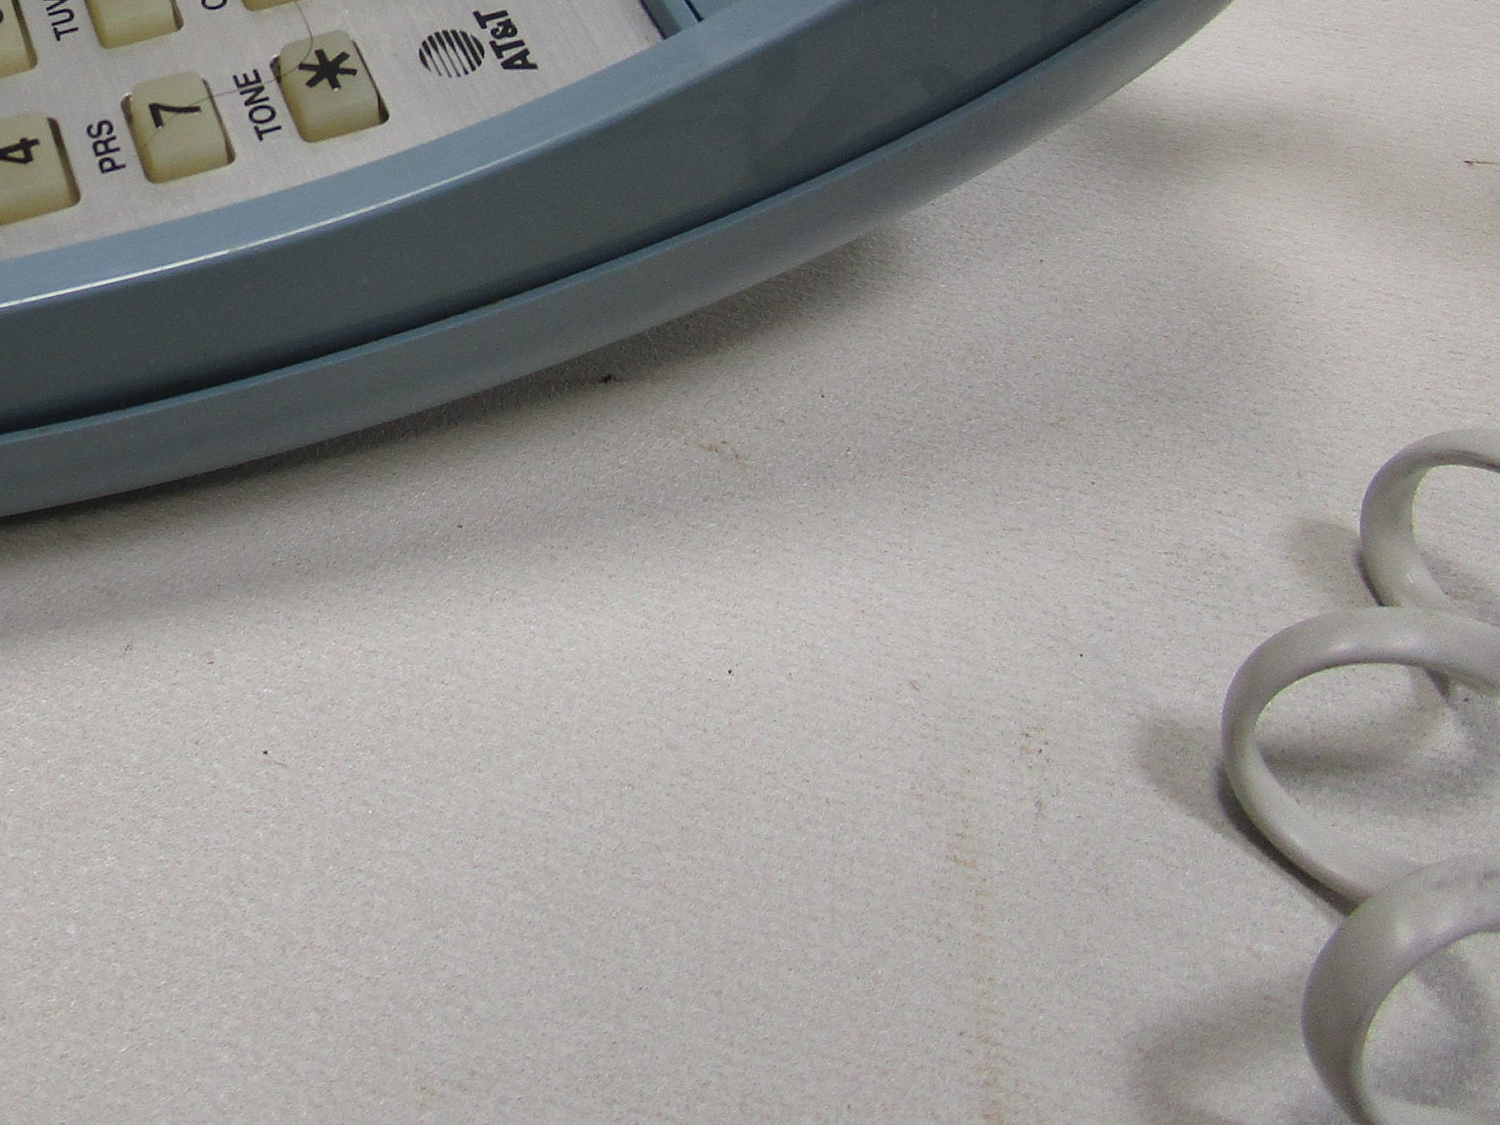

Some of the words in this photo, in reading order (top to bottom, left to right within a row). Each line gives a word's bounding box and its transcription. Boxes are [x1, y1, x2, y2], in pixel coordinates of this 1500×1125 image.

[473, 8, 538, 71] AT&T
[150, 101, 201, 129] 7
[233, 68, 282, 141] TONE
[87, 119, 126, 173] PRS
